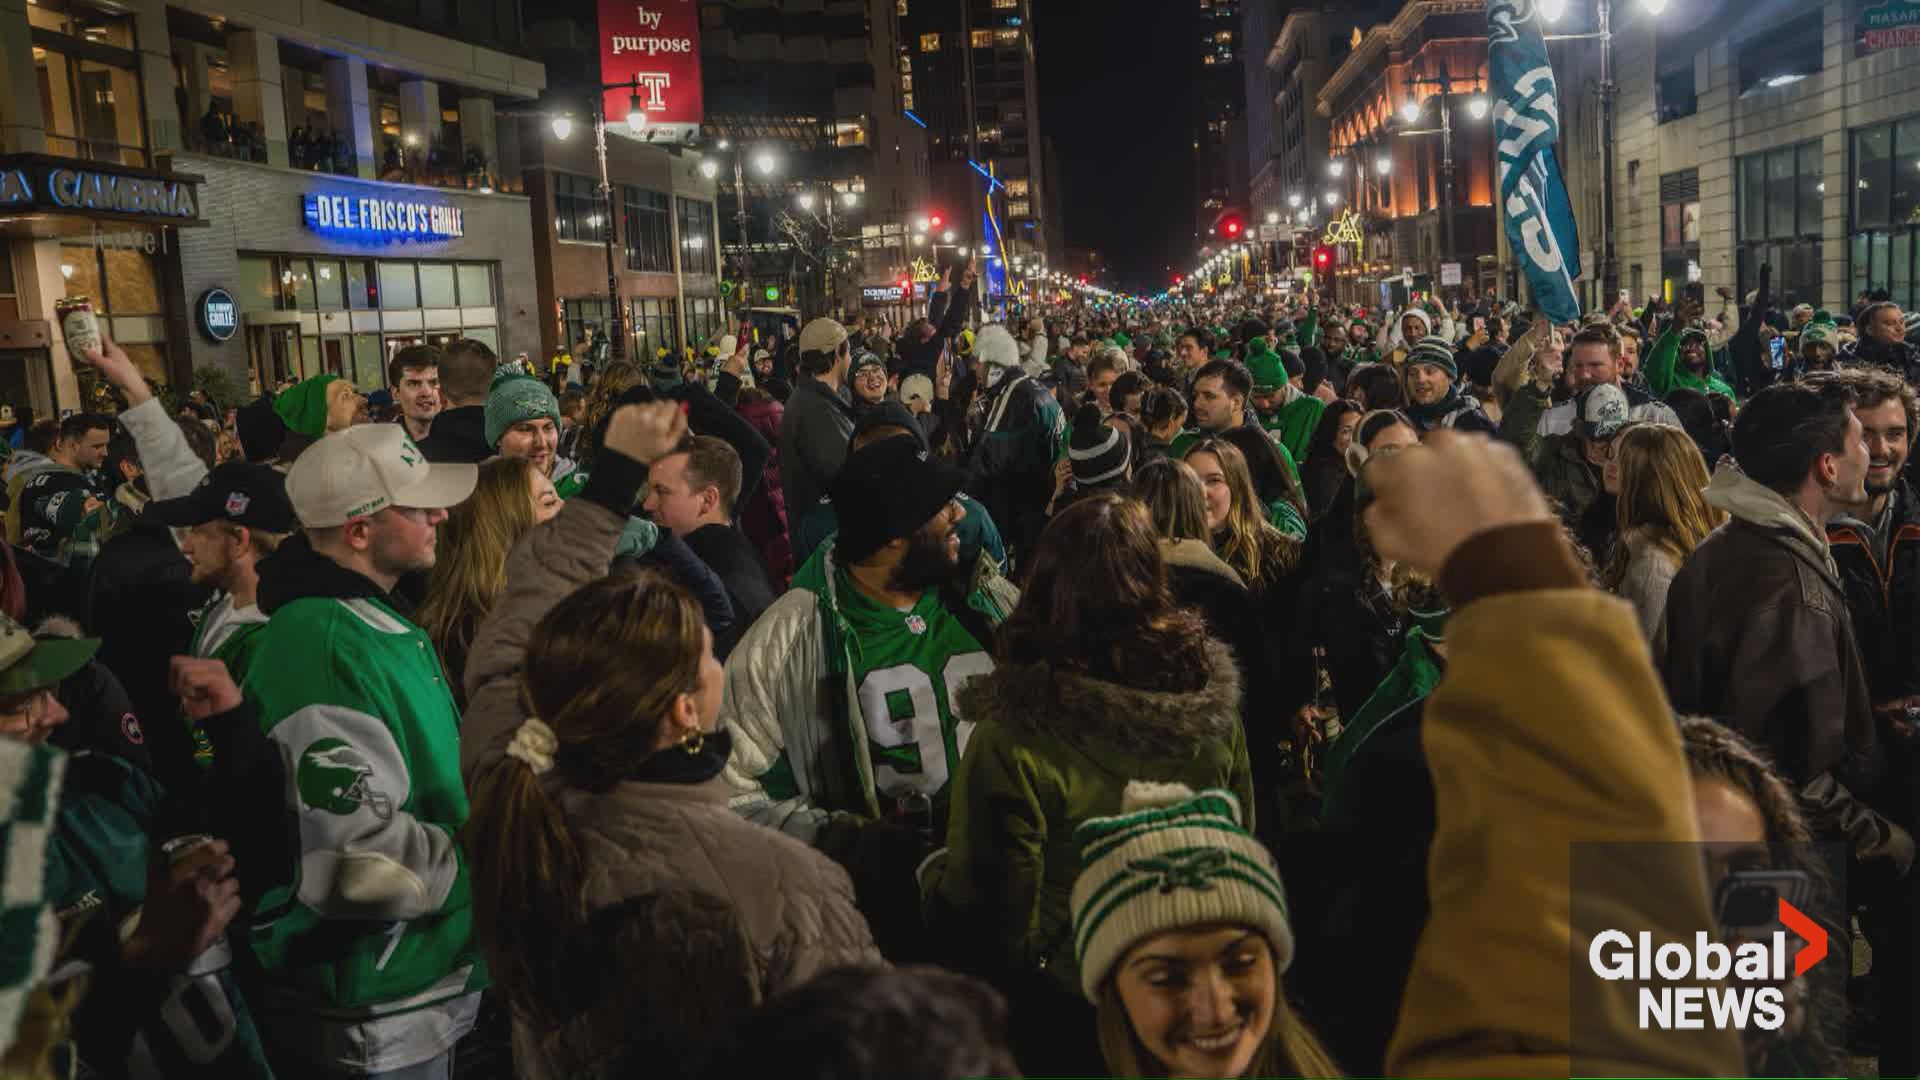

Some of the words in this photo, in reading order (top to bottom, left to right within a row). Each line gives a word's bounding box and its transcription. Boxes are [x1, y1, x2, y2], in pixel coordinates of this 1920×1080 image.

[638, 6, 661, 30] by
[612, 37, 691, 56] purpose
[49, 167, 199, 218] CAMBRIA
[317, 195, 355, 228] DEL
[359, 198, 428, 233] FRISCO'S
[431, 205, 464, 237] GRILLE
